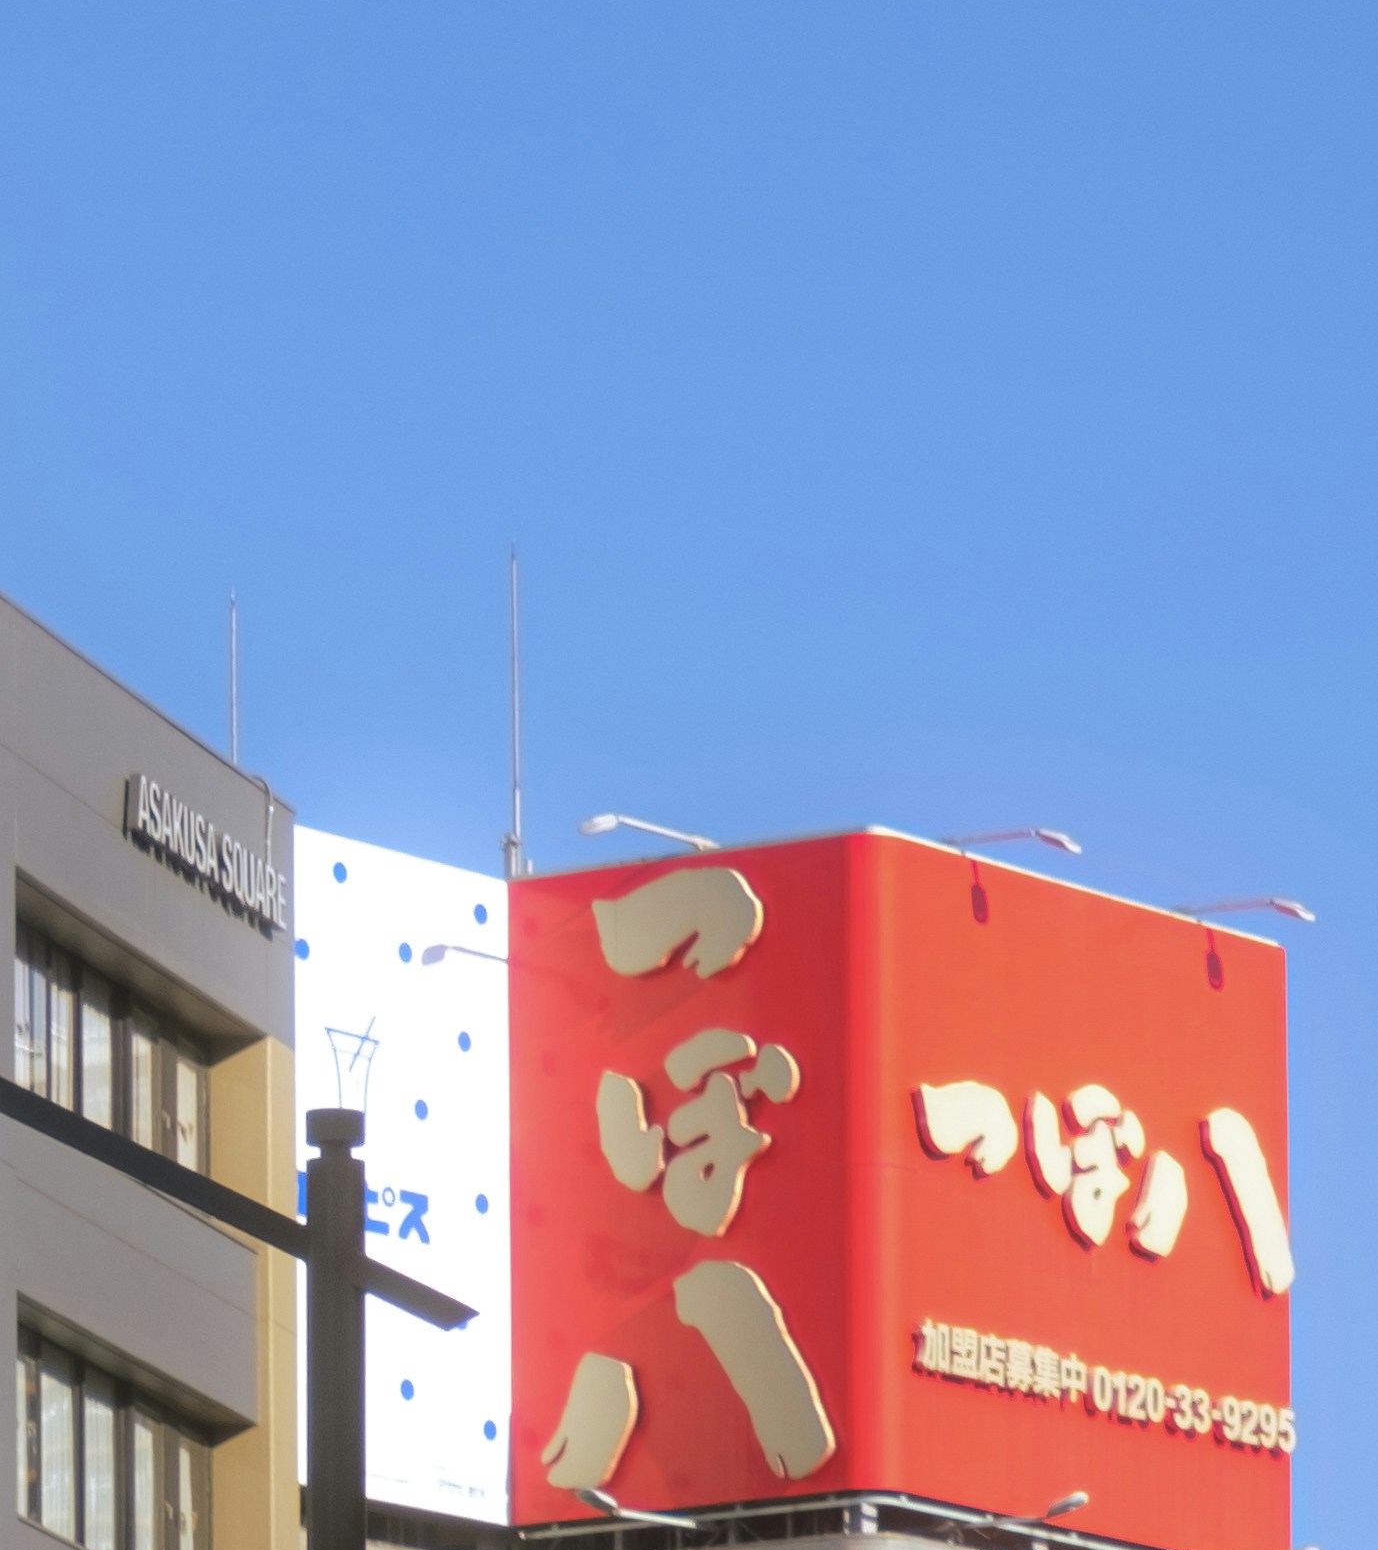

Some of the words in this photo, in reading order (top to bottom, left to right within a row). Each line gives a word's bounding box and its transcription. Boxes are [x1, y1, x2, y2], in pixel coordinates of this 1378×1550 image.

[138, 774, 219, 883] ASAKUSA
[222, 832, 287, 932] SQUARE
[540, 866, 838, 1490] つぼ八
[918, 1078, 1296, 1296] つぼ八
[917, 1316, 1089, 1404] 加盟店募集中
[1091, 1365, 1297, 1454] 0120-33-9295
